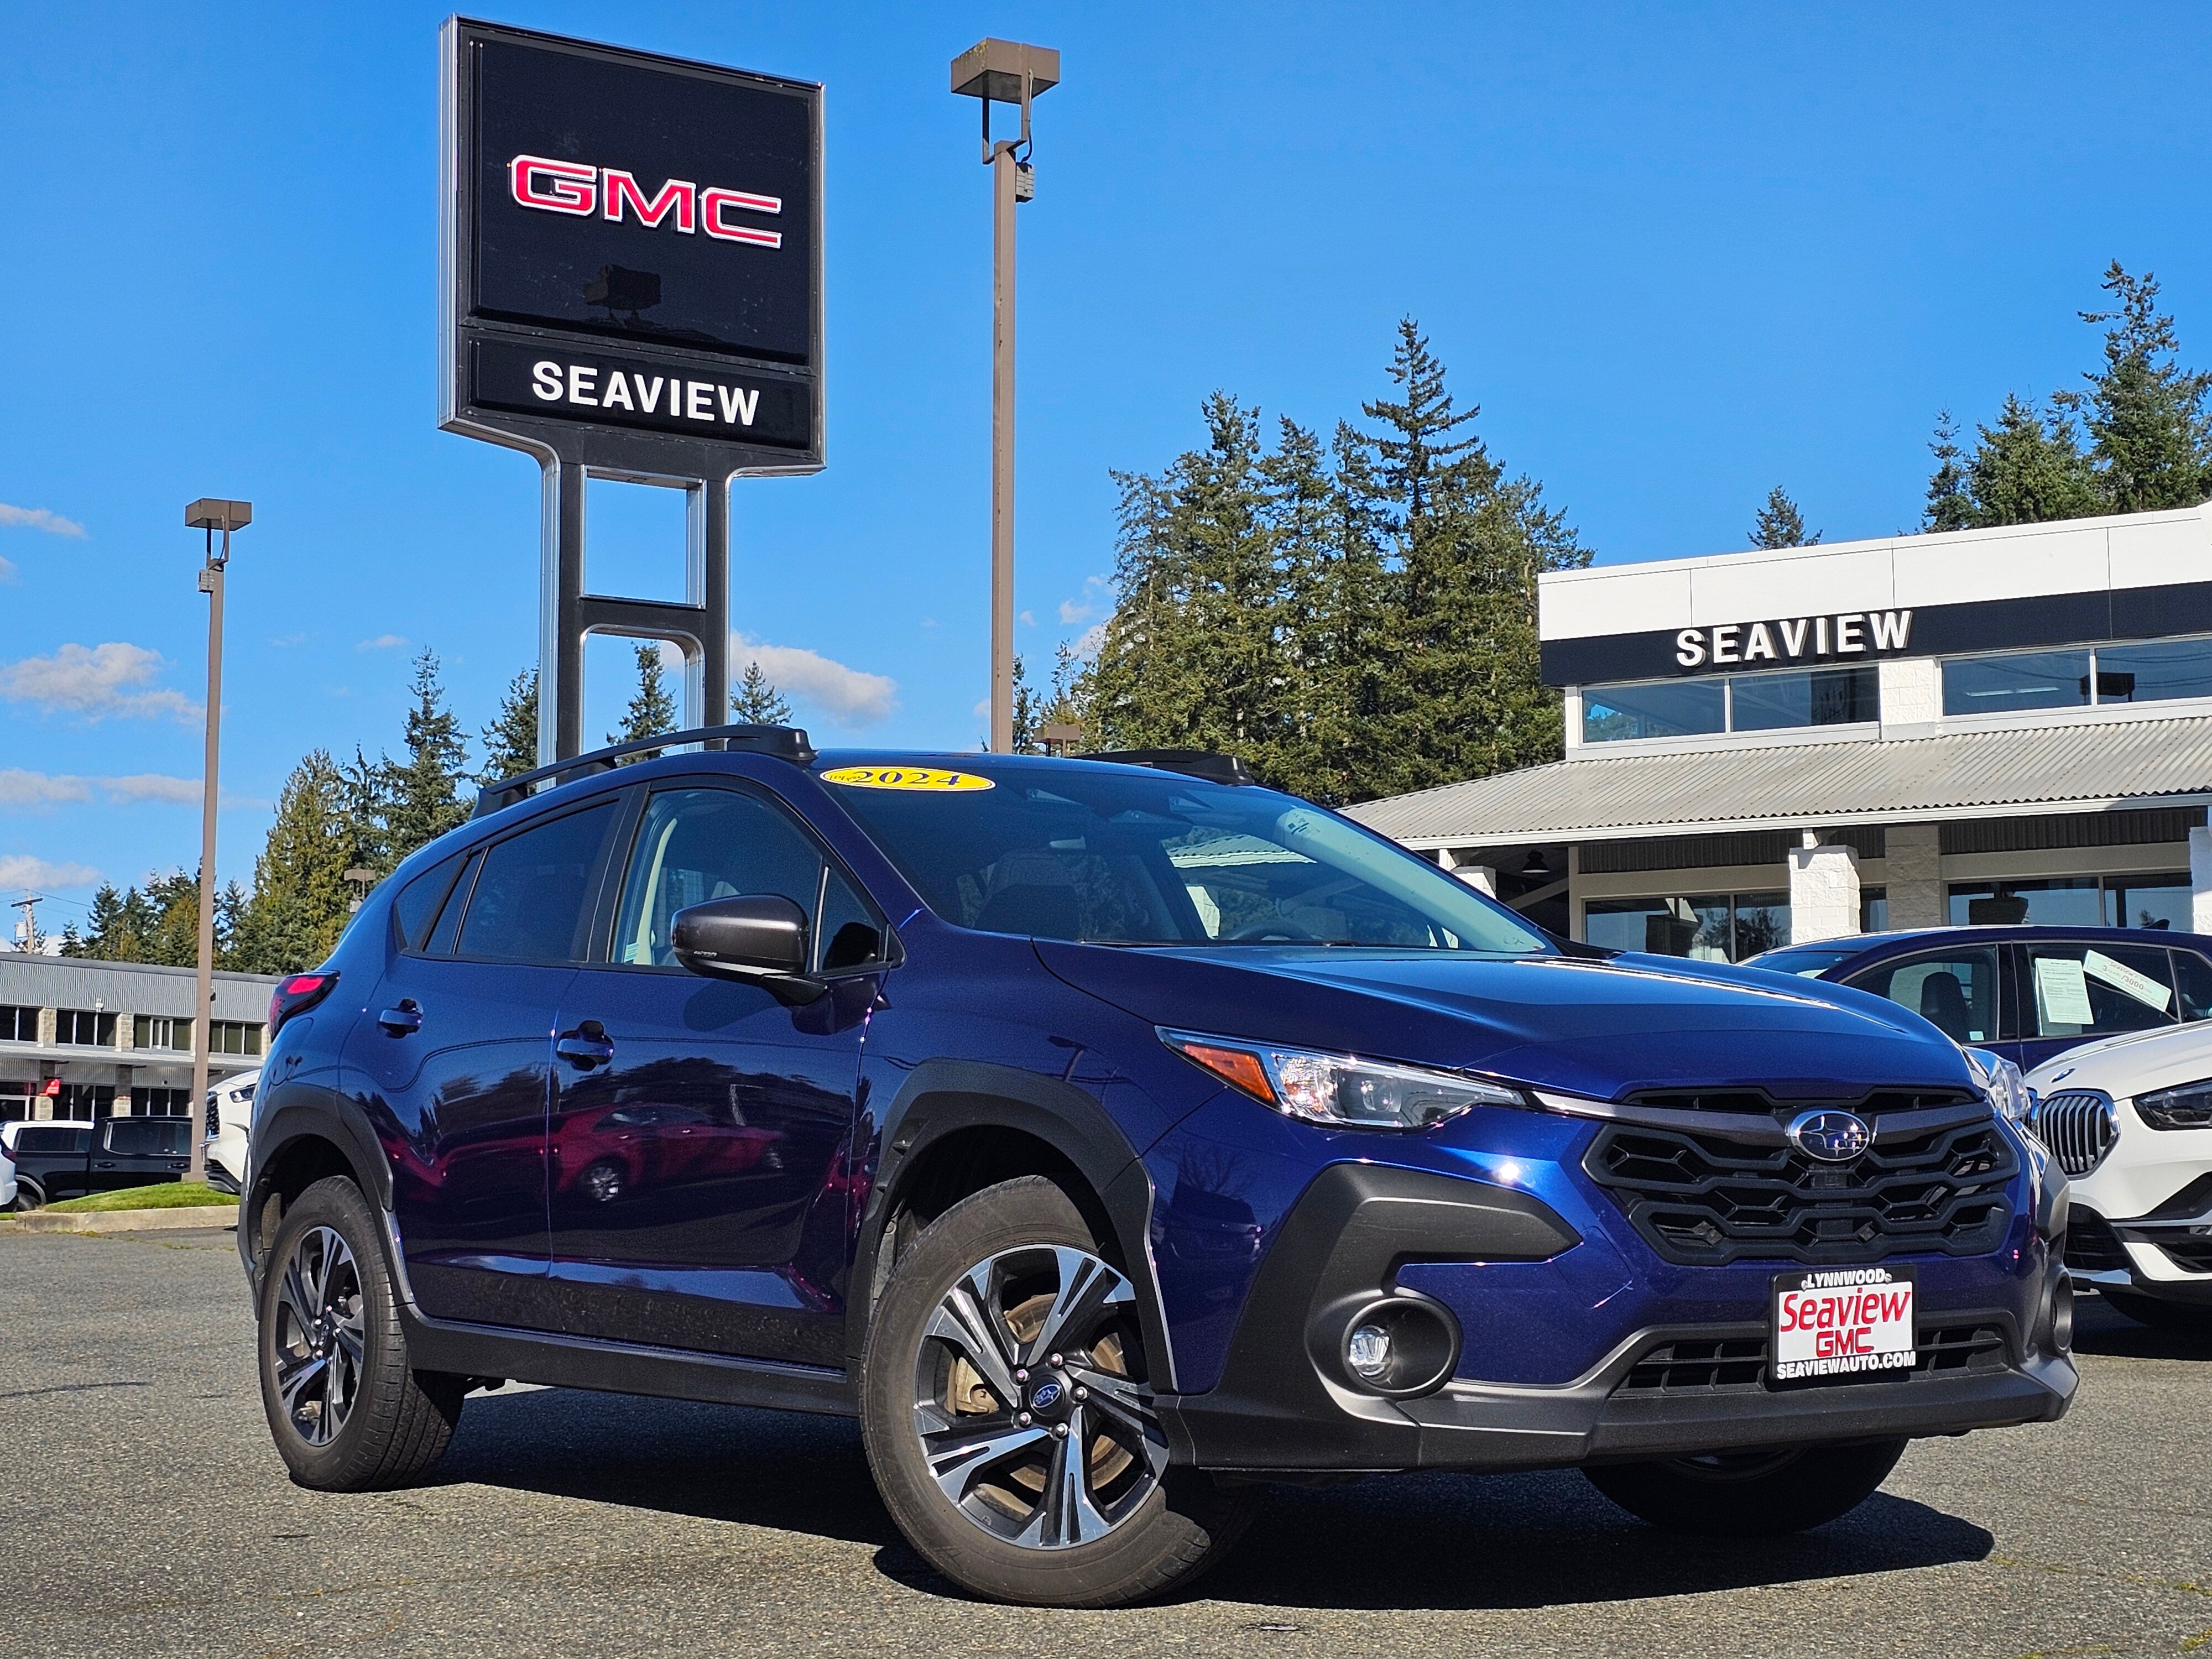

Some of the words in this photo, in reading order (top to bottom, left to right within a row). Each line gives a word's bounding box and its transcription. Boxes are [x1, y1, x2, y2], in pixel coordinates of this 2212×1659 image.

[511, 154, 782, 248] GMC
[533, 361, 760, 426] SEAVIEW
[1676, 610, 1913, 667] SEAVIEW
[849, 771, 961, 786] 2024
[1807, 1268, 1885, 1288] LYNNWOOD
[1780, 1287, 1911, 1332] Seaview
[1816, 1327, 1873, 1358] GMC
[1776, 1350, 1916, 1380] SEAVIEWAUTO.COM
